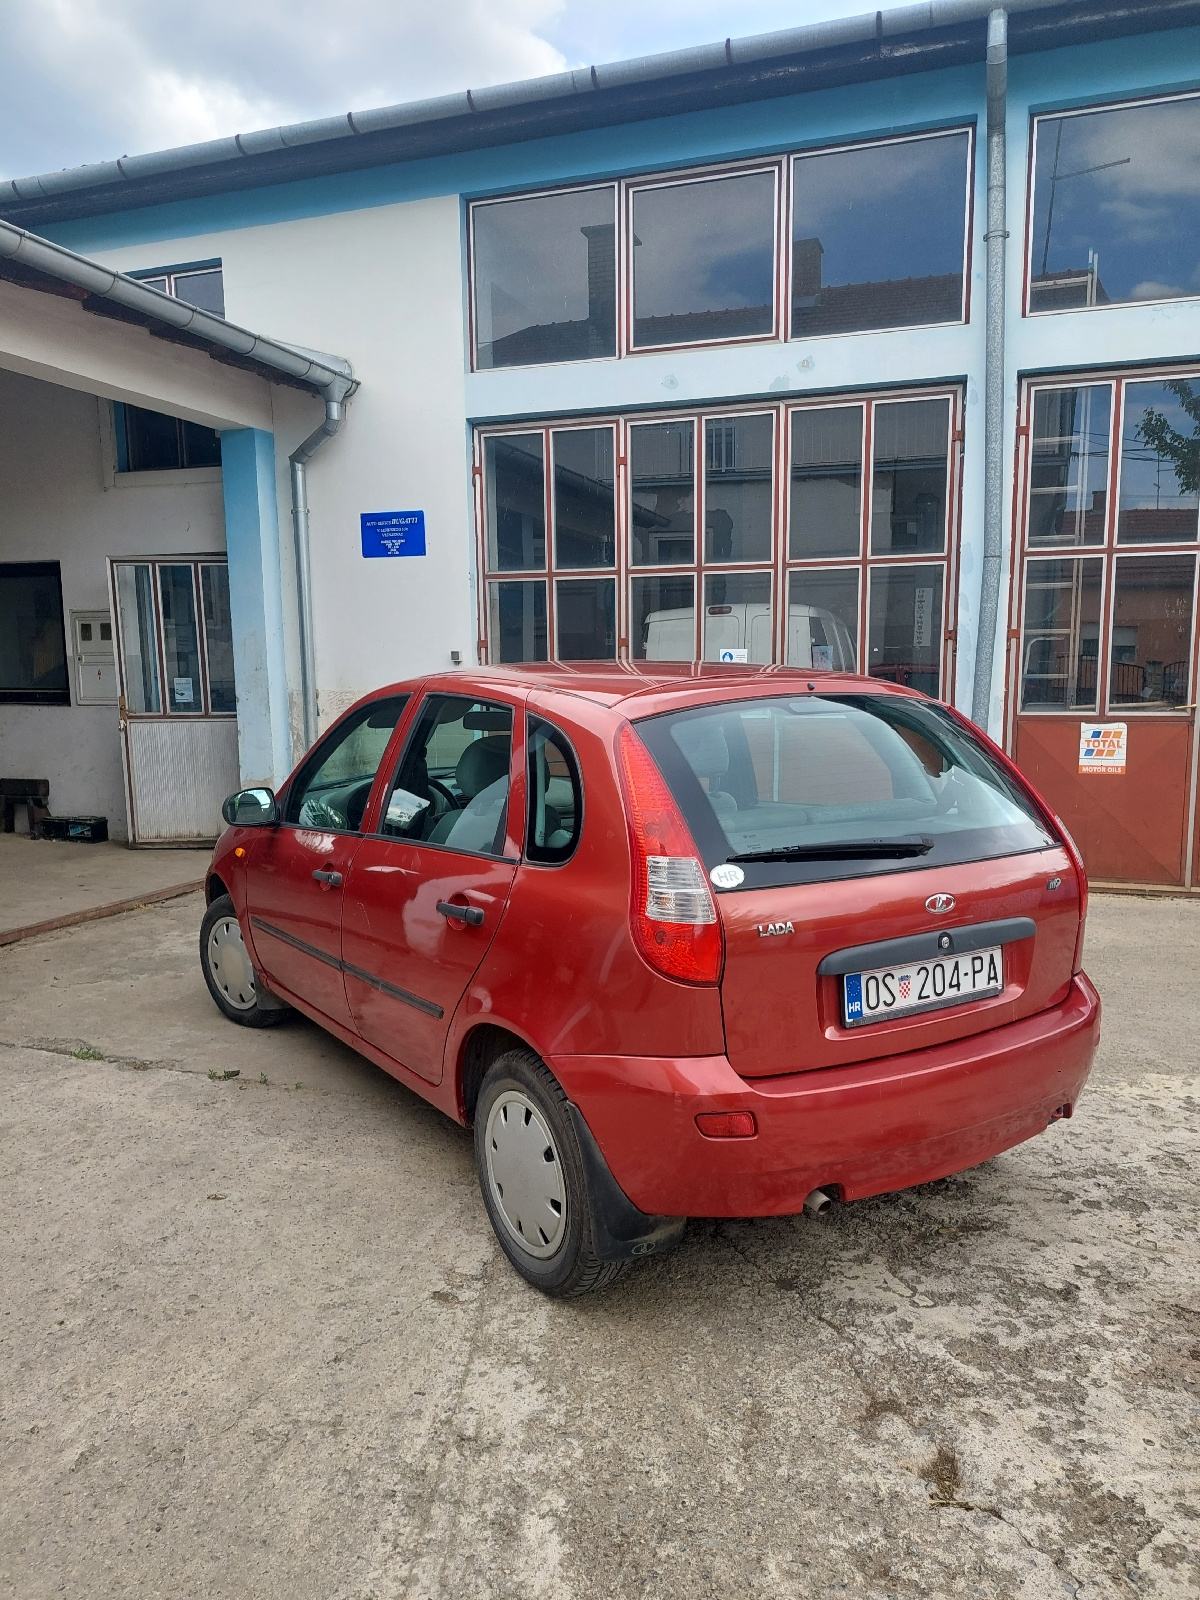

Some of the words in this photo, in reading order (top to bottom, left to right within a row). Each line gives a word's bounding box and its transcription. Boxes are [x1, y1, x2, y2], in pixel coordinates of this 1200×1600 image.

[1085, 739, 1122, 749] TOTAL
[716, 870, 740, 883] HR
[757, 920, 795, 937] LADA
[865, 973, 897, 1011] OS
[916, 953, 999, 1001] 204-PA
[848, 1001, 862, 1014] HR
